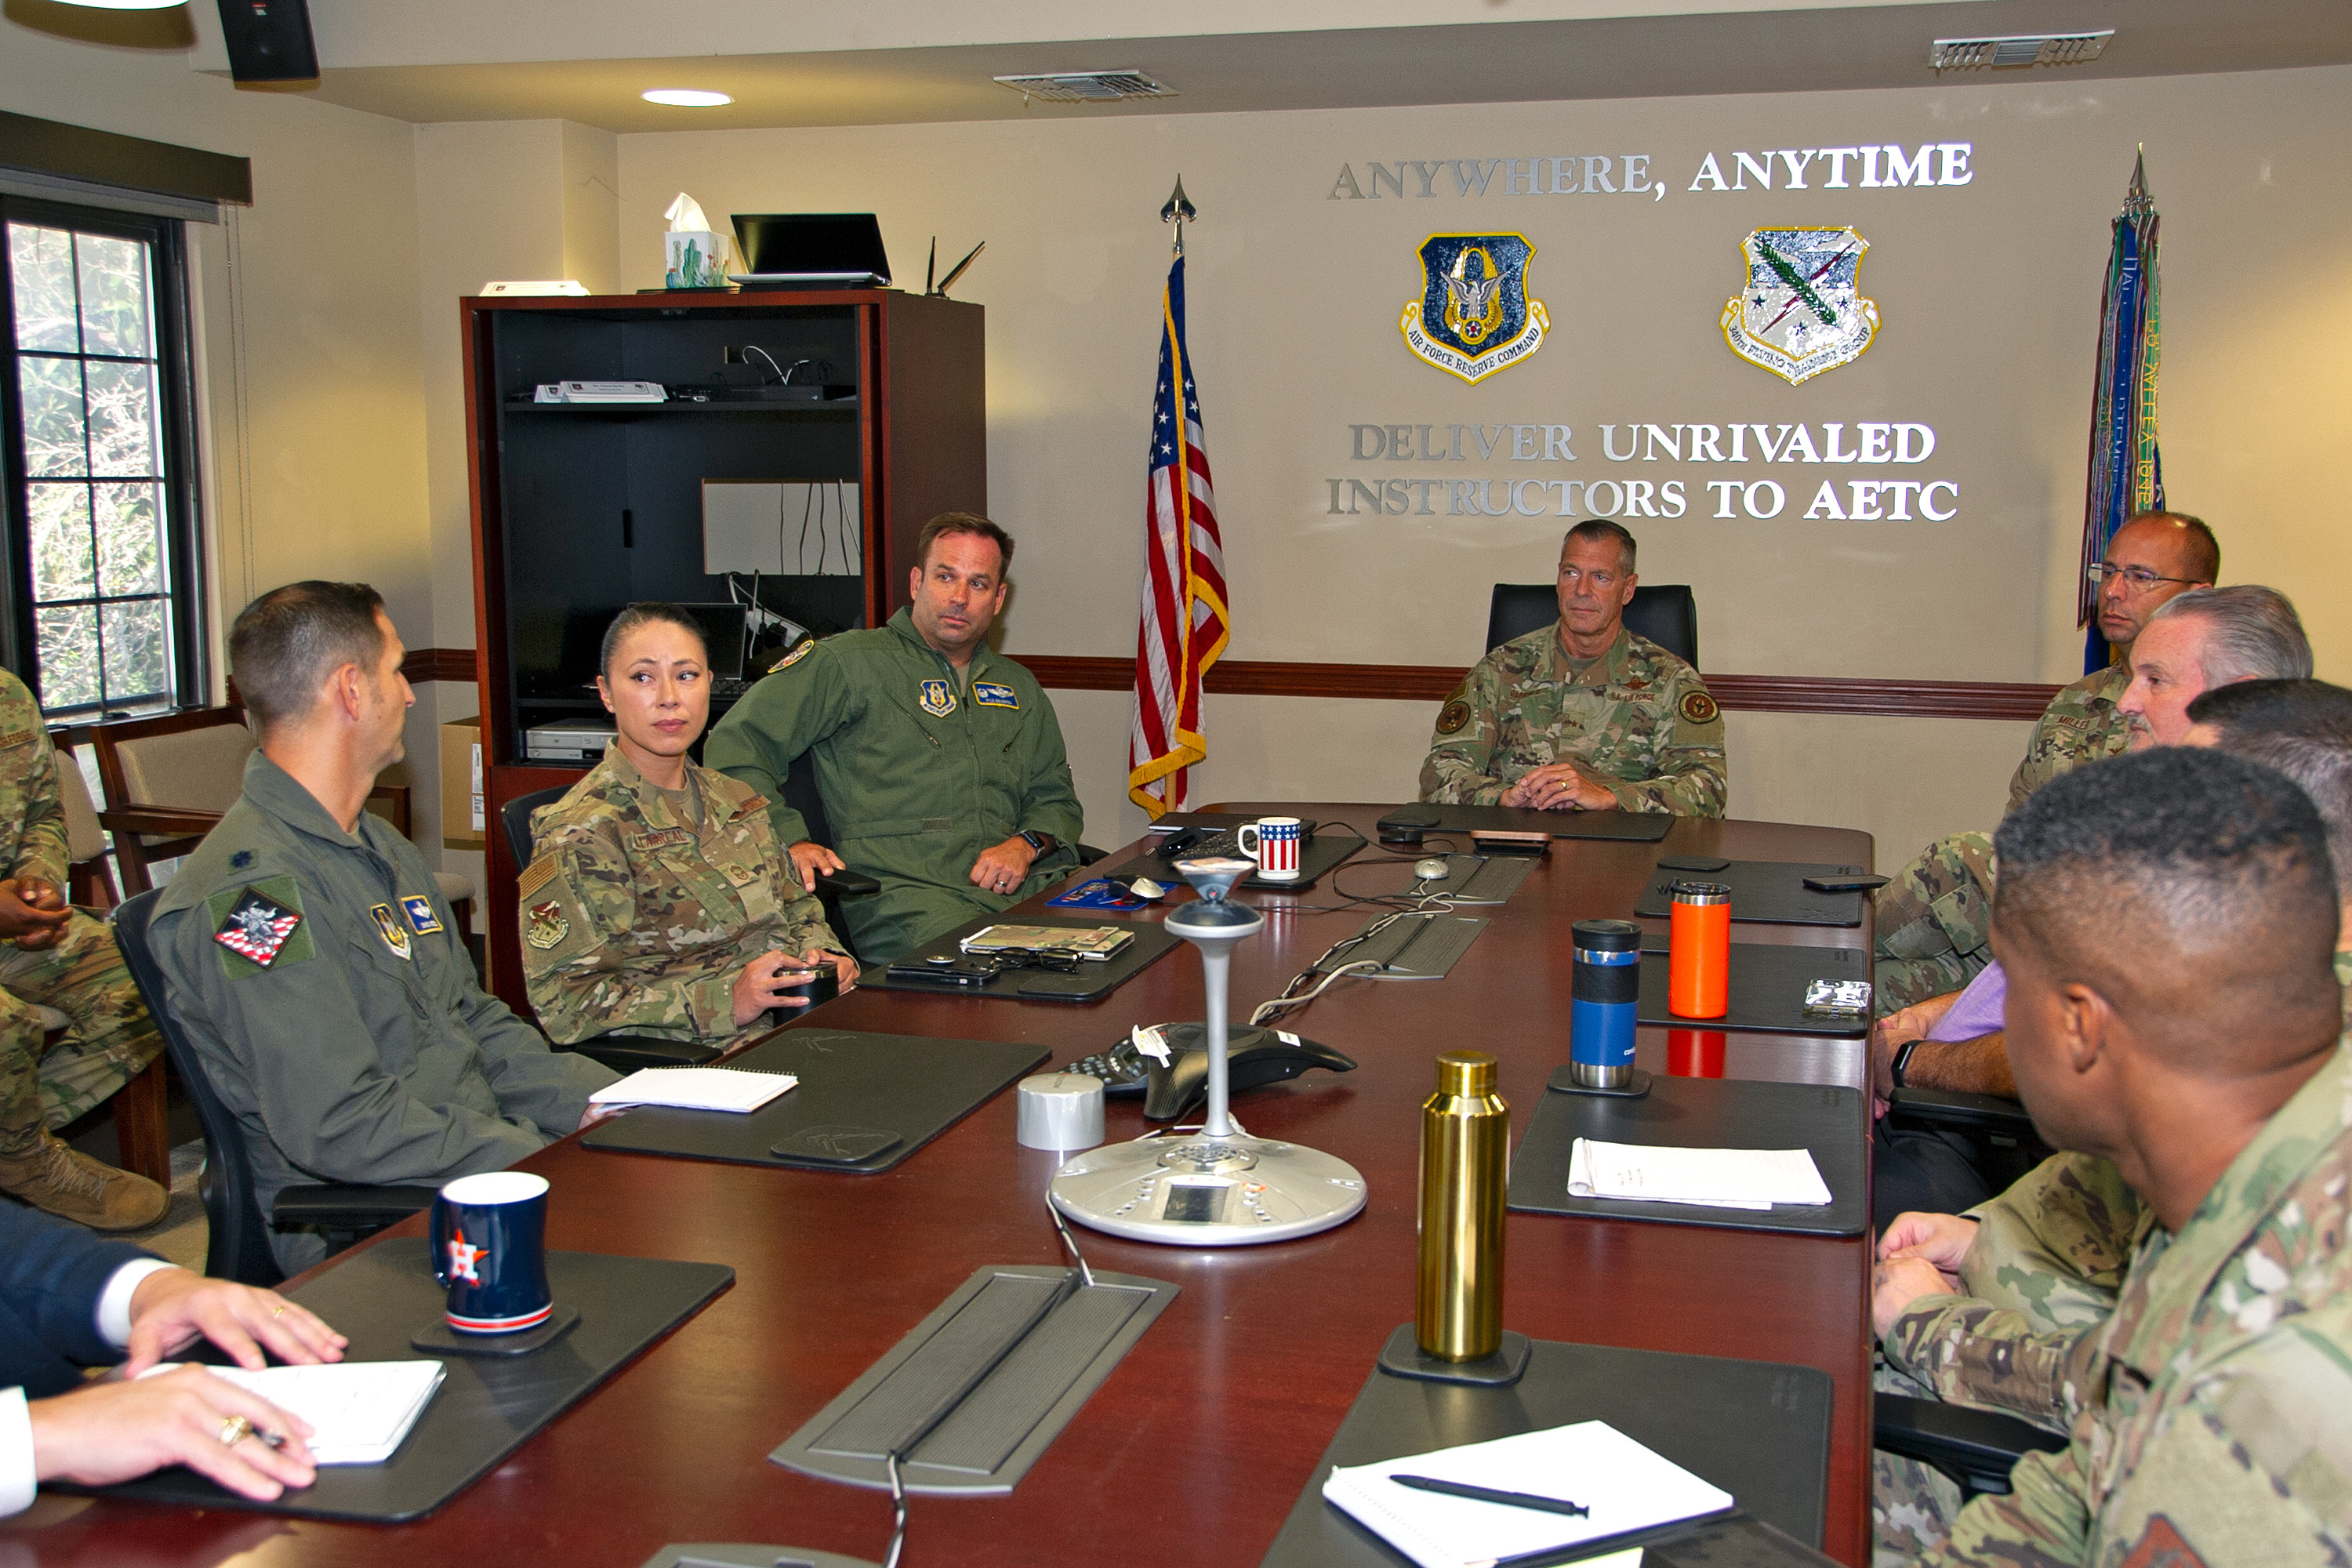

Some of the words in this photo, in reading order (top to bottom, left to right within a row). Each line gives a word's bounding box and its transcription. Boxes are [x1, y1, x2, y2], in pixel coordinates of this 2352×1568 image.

[1327, 154, 1667, 202] ANYWHERE,
[1687, 143, 1973, 191] ANYTIME
[1408, 329, 1425, 349] AIR
[1422, 343, 1453, 366] FORCE
[1455, 356, 1495, 377] RESERVE
[1497, 327, 1540, 364] COMMAND
[1747, 345, 1785, 368] FLYING
[1349, 423, 1578, 462] DELIVER
[1598, 422, 1936, 464] UNRIVALED
[1326, 478, 1686, 518] INSTRUCTORS
[1707, 480, 1786, 520] TO
[1803, 479, 1958, 521] AETC
